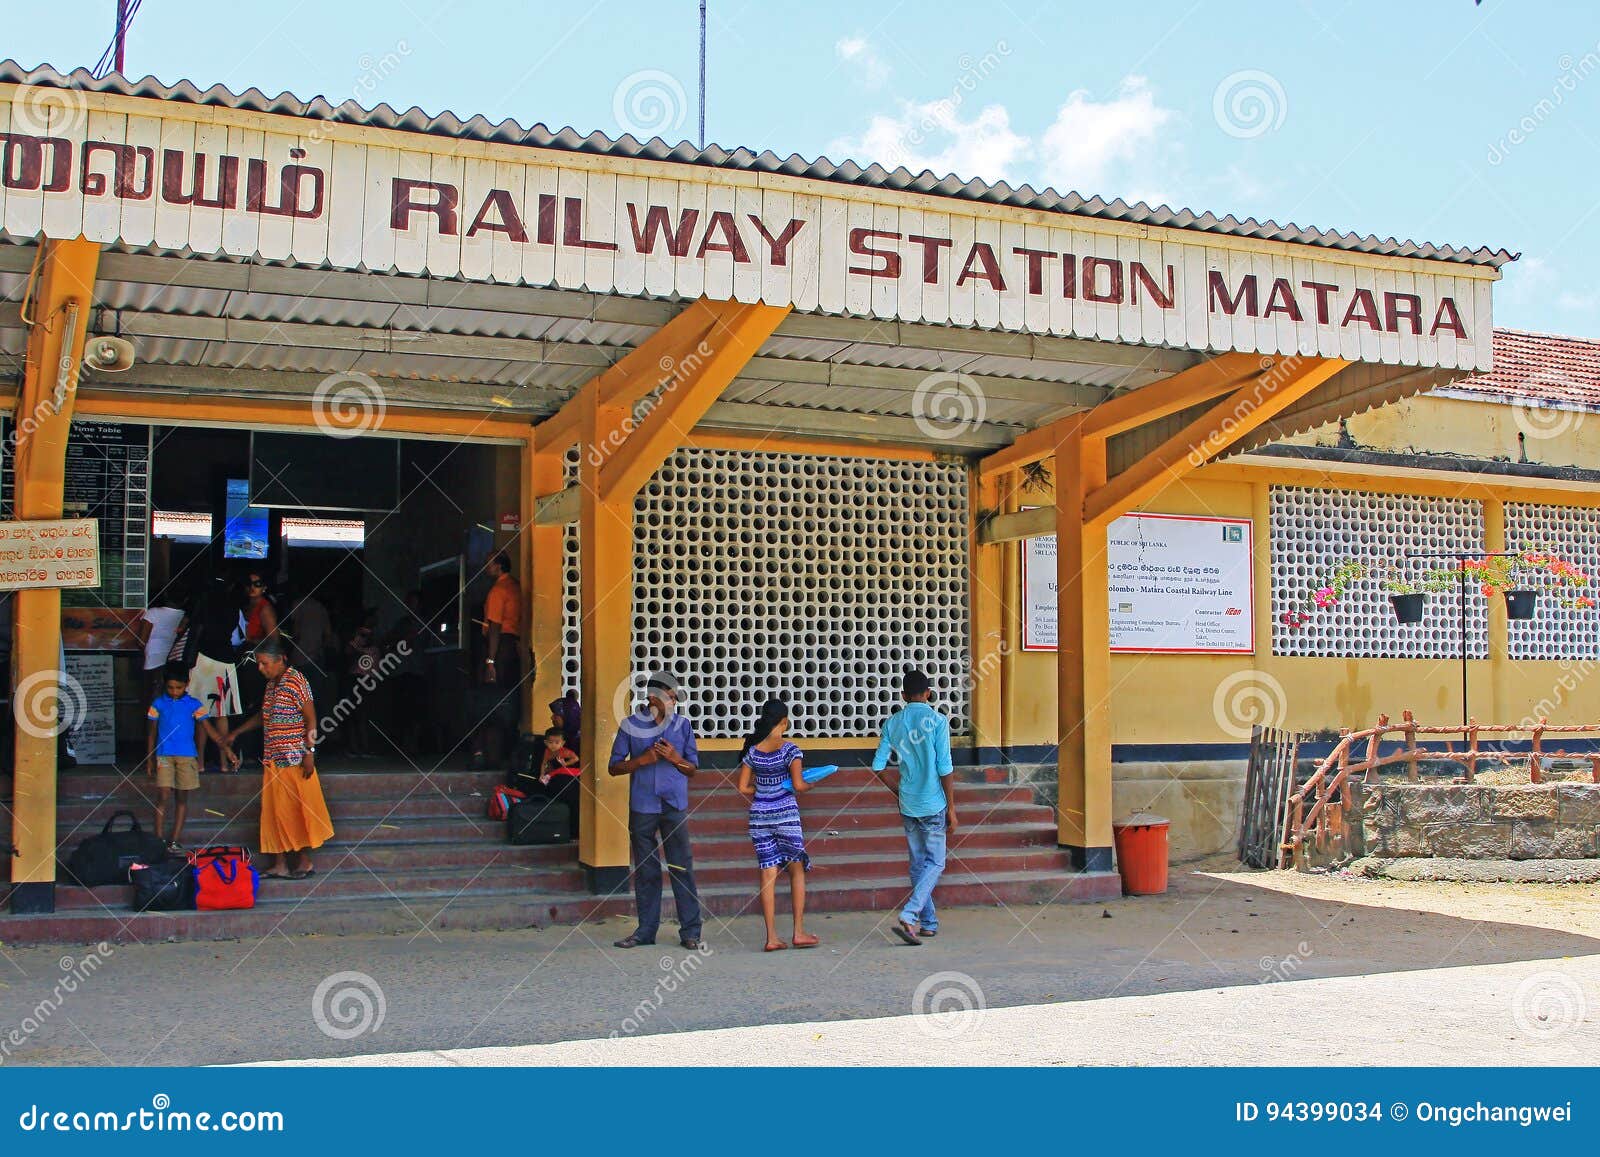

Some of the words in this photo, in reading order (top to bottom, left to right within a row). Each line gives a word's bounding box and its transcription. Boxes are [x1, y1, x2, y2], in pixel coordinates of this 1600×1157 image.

[391, 178, 806, 267] RAILWAY
[848, 227, 1175, 310] STATION
[1208, 270, 1468, 339] MATARA
[1108, 584, 1135, 593] olombo
[1140, 585, 1164, 594] Matara
[1165, 586, 1190, 595] Coastal
[1191, 587, 1217, 597] Railway
[1218, 587, 1233, 596] Line
